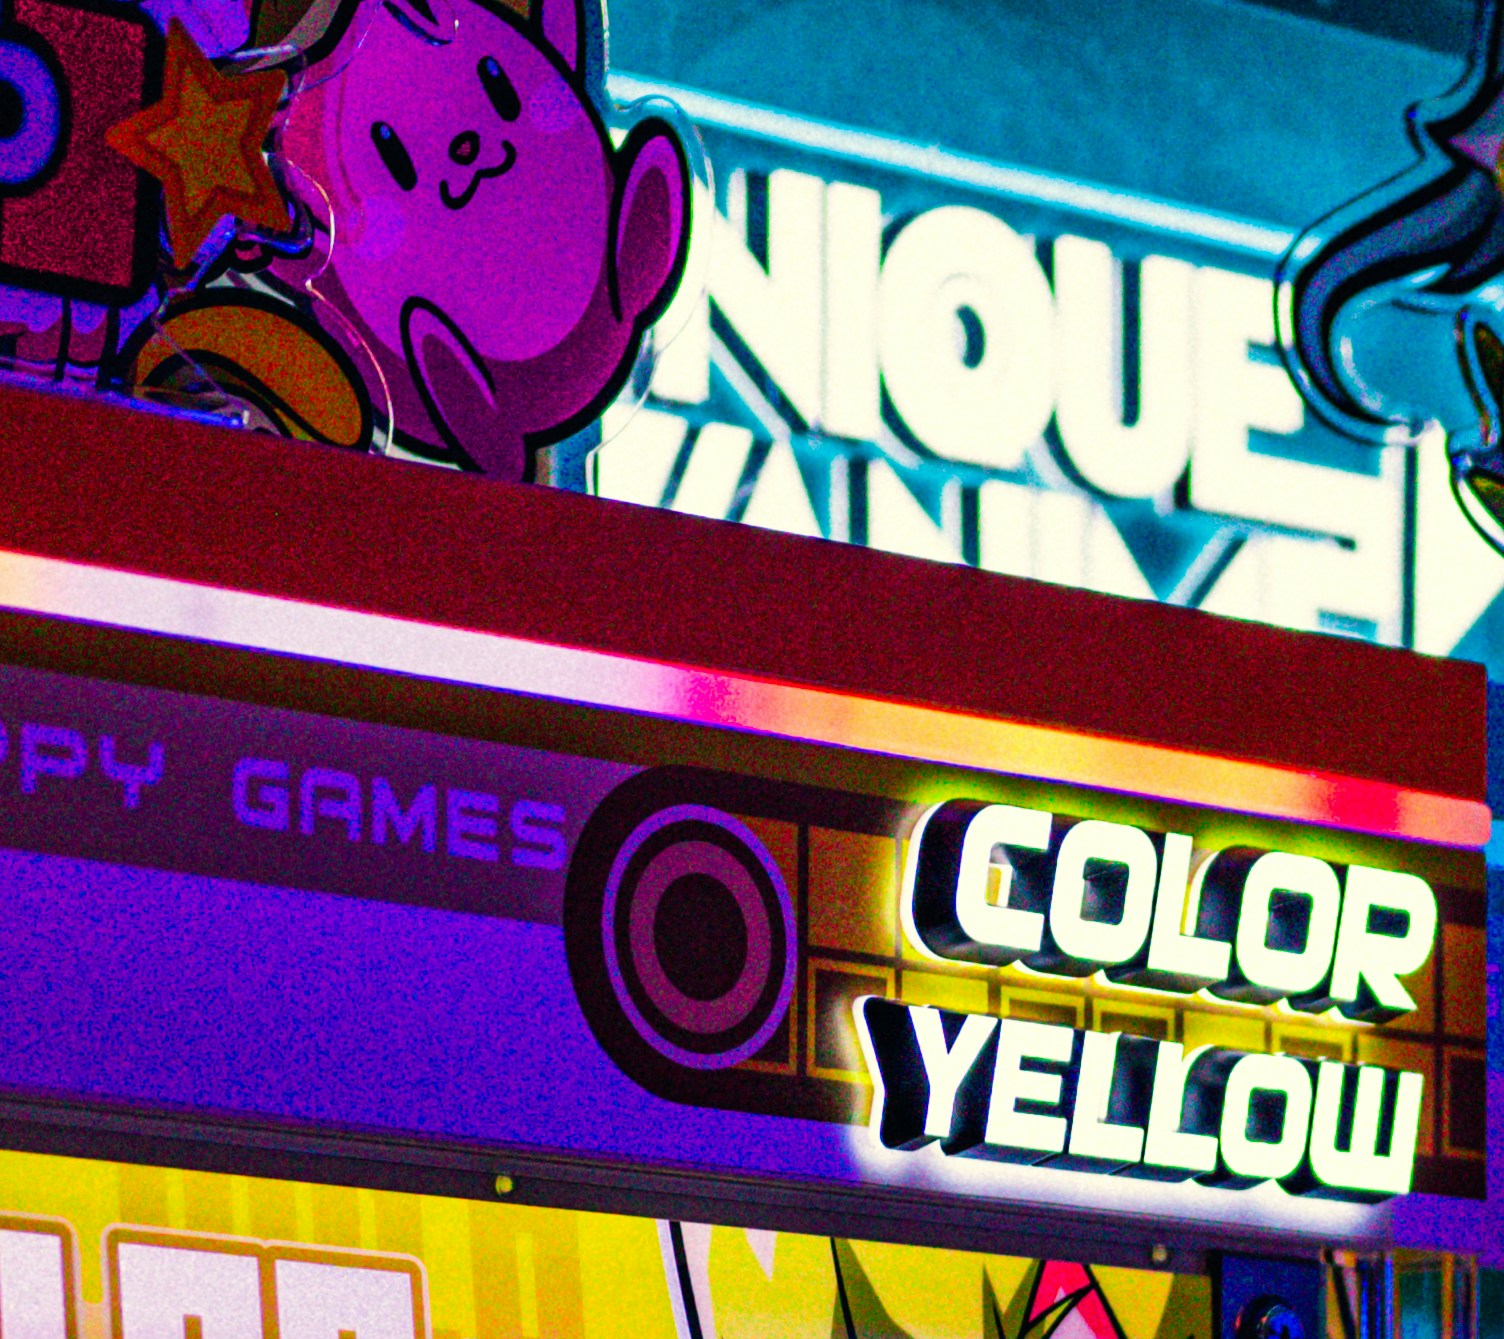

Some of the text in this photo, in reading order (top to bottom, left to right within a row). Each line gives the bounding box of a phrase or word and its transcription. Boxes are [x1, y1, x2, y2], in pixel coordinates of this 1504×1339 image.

[231, 757, 567, 873] GAMES
[951, 797, 1438, 1014] COLOR
[907, 1002, 1427, 1198] YELLOW
